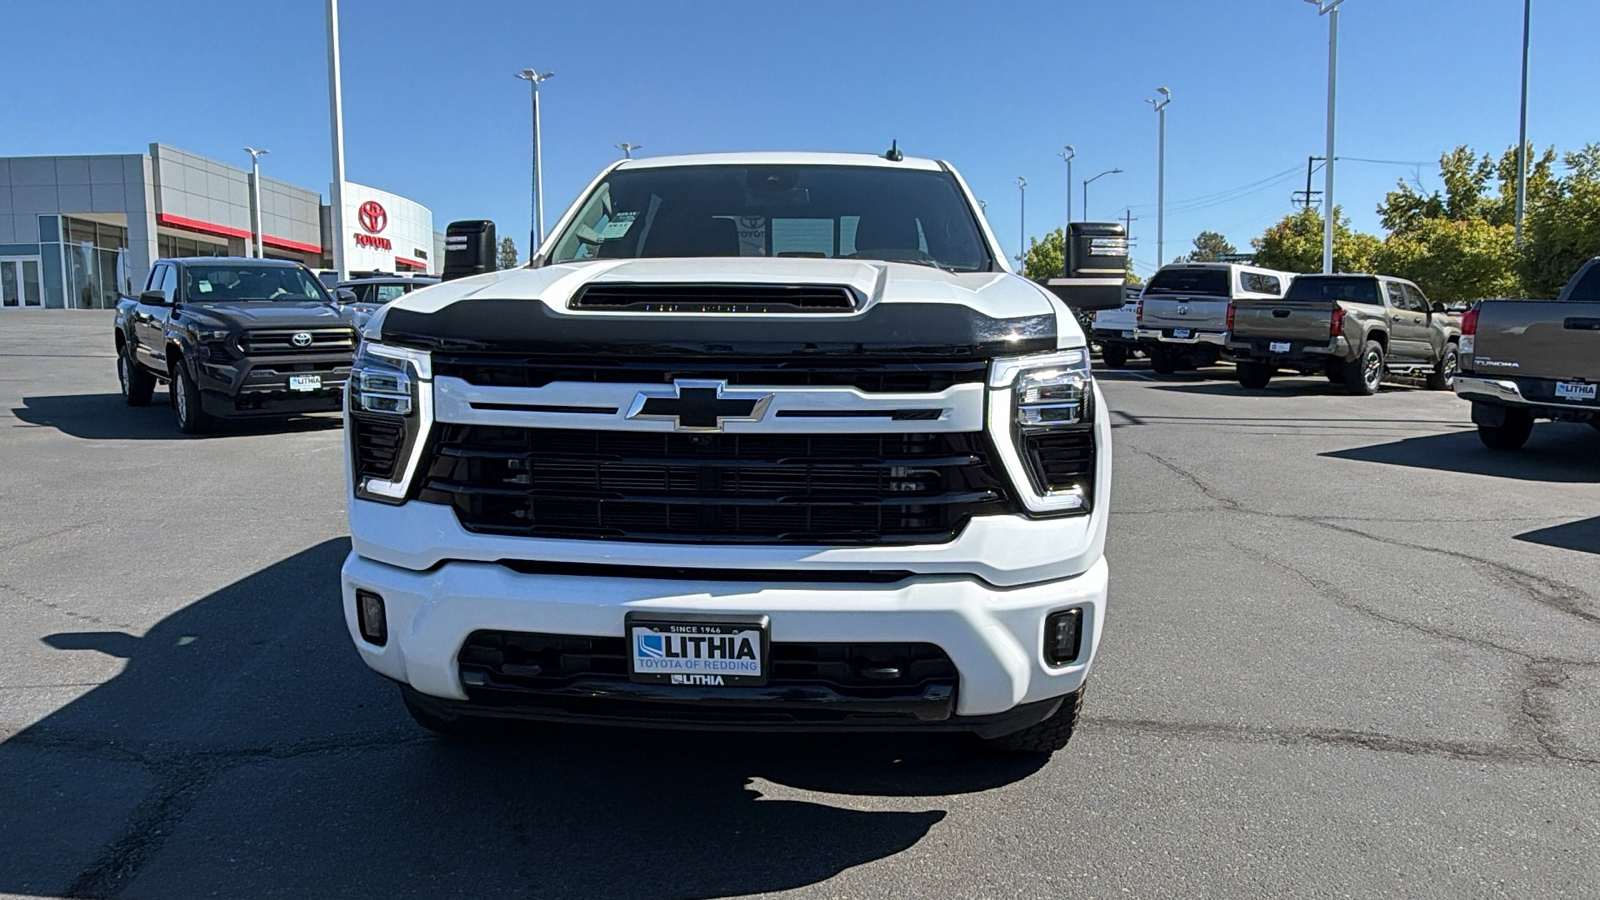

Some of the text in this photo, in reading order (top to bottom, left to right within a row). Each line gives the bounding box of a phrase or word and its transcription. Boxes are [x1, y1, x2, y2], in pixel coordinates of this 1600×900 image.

[353, 233, 392, 251] TOYOTA
[1474, 360, 1519, 368] TUNDRA
[298, 376, 320, 385] LITHIA
[1565, 385, 1594, 394] LITHIA
[670, 625, 721, 634] SINCE 1946
[664, 635, 756, 660] LITHIA
[640, 659, 757, 671] TOYOTA OF REDDING
[683, 674, 724, 686] LITHIA
